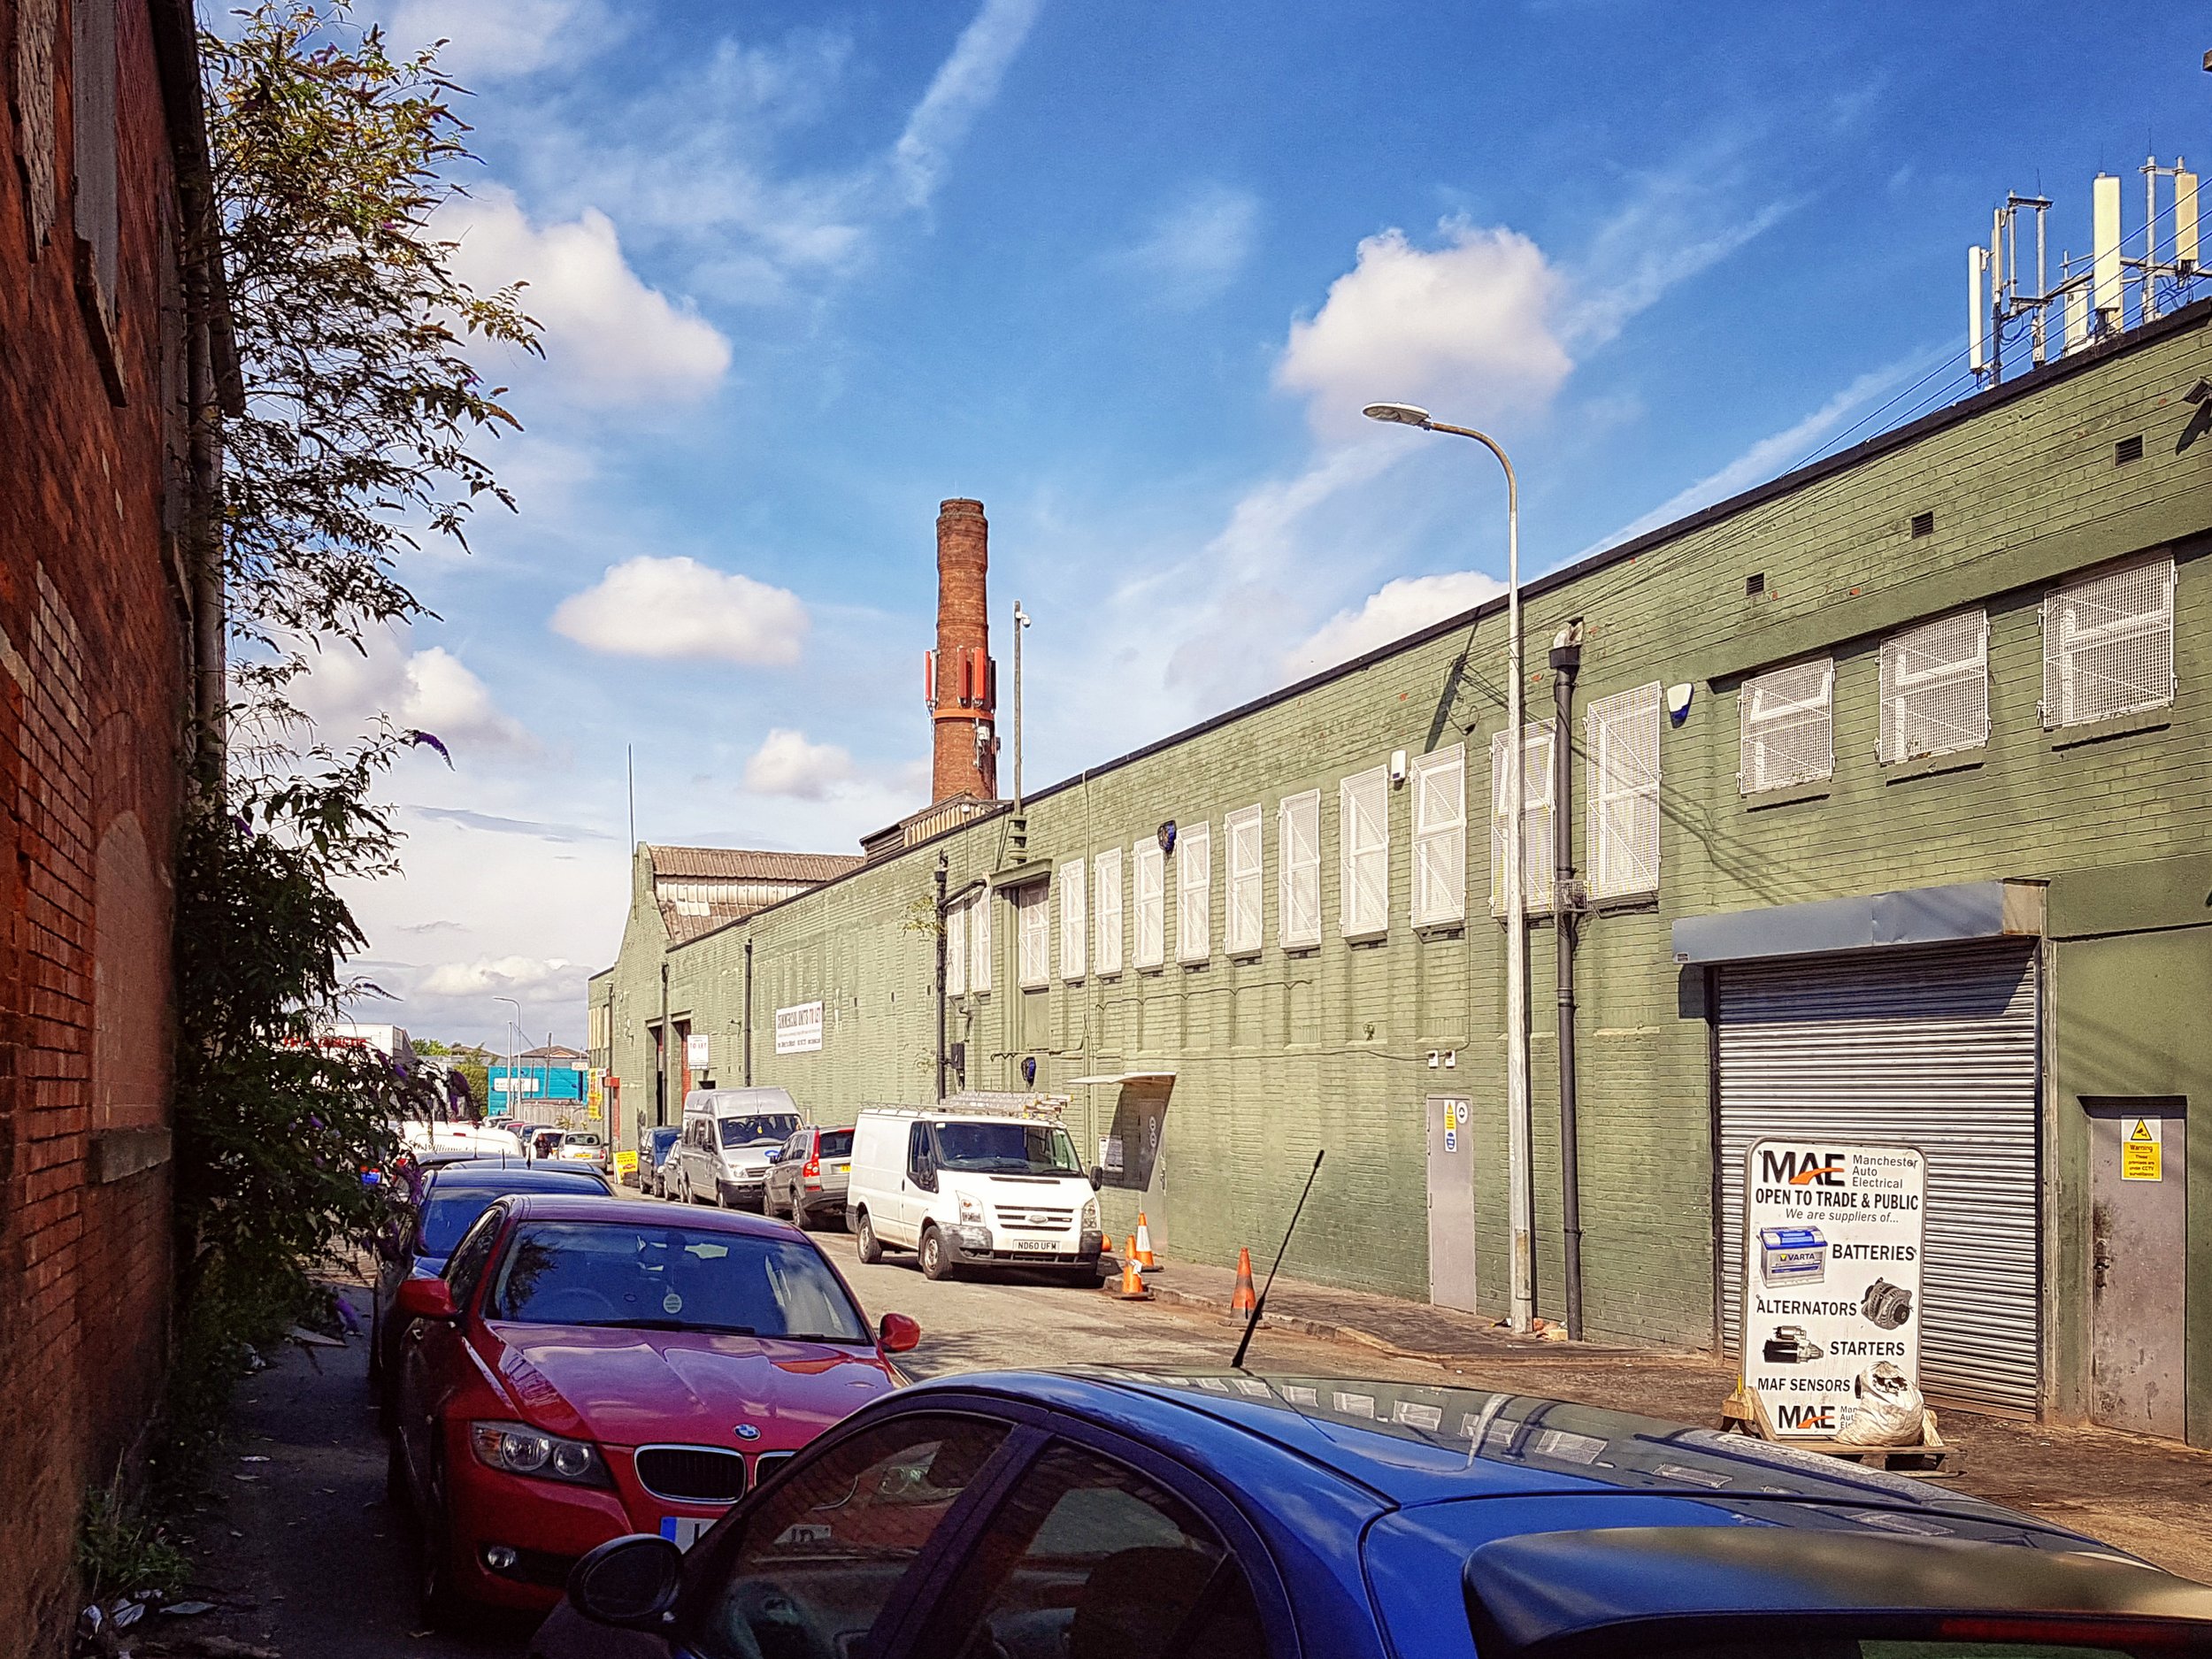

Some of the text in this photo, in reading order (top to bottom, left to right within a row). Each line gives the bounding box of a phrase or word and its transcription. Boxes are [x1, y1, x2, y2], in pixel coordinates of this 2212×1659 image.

[2129, 1144, 2153, 1153] Warning
[1763, 1150, 1846, 1187] MAE
[1853, 1154, 1918, 1168] Manchester
[1853, 1167, 1878, 1177] Auto
[1852, 1177, 1903, 1188] Electrical
[1755, 1187, 1918, 1210] OPEN TO TRADE & PUBLIC
[1786, 1208, 1899, 1223] We are suppliers of...
[1832, 1243, 1916, 1261] BATTERIES
[1756, 1299, 1857, 1316] ALTERNATORS
[1830, 1340, 1905, 1356] STARTERS
[1757, 1378, 1851, 1392] MAF SENSORS
[1778, 1405, 1836, 1430] MAE
